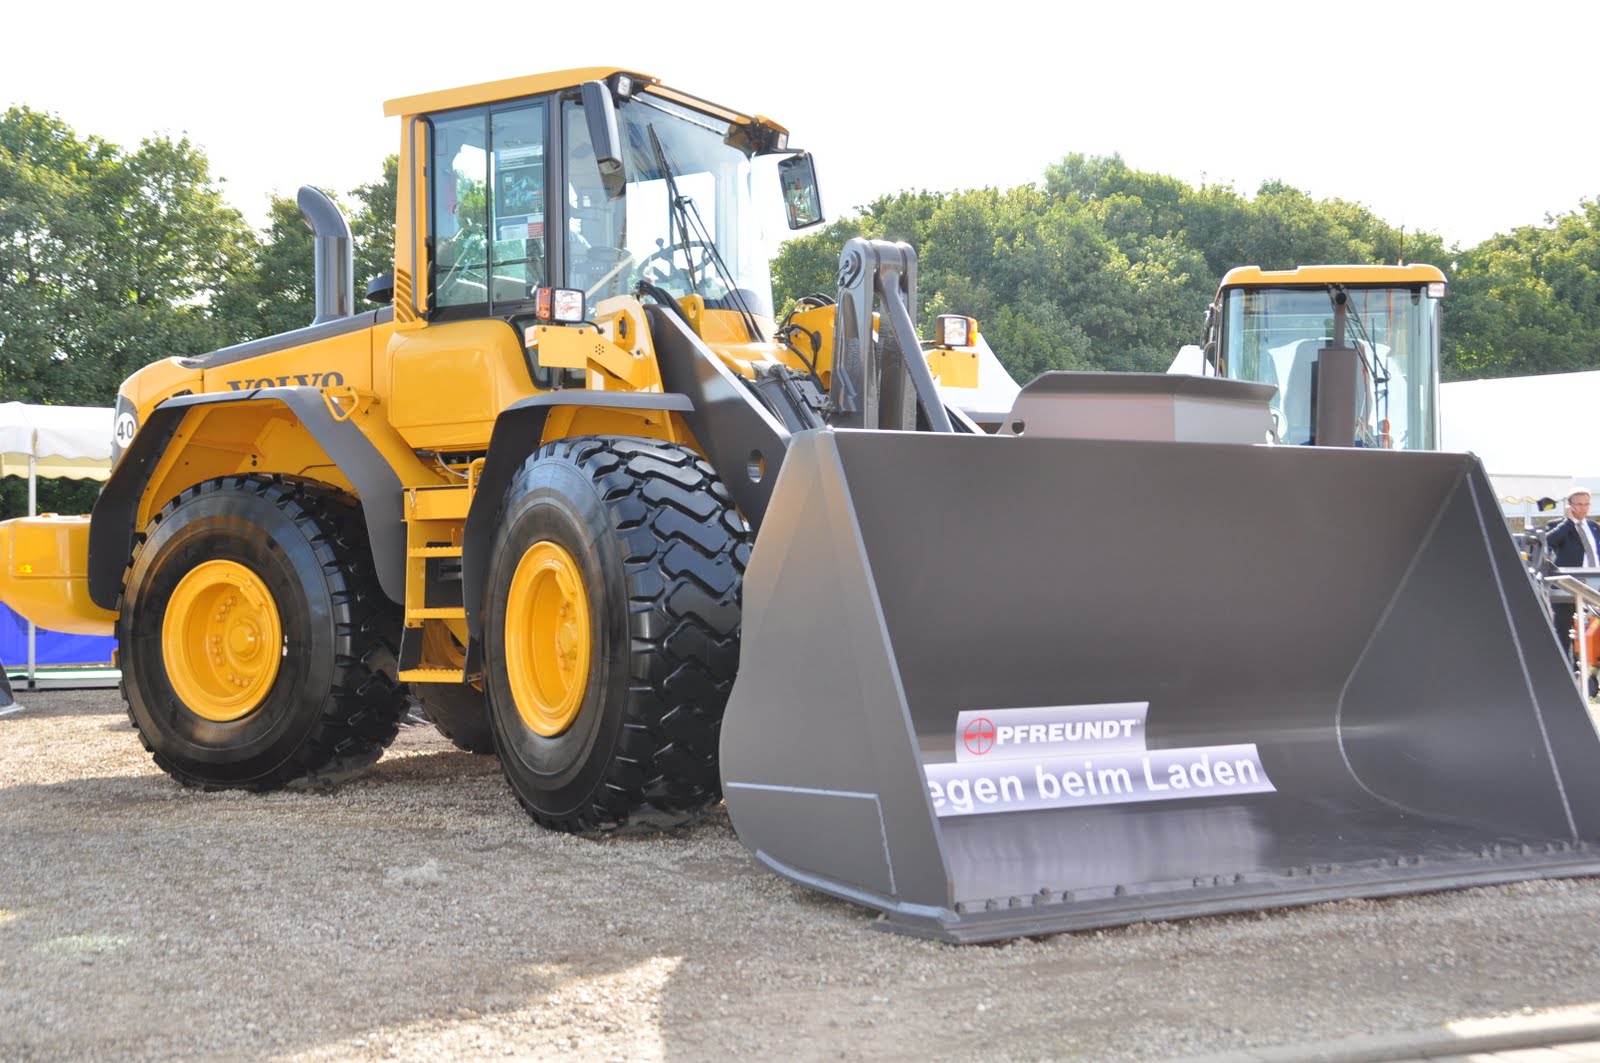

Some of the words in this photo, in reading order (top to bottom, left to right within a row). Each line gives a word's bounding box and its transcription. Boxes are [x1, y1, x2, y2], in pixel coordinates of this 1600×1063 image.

[117, 421, 134, 440] 40
[996, 719, 1136, 745] PFREUNDT
[1035, 760, 1133, 800] beim
[1142, 752, 1260, 791] Laden
